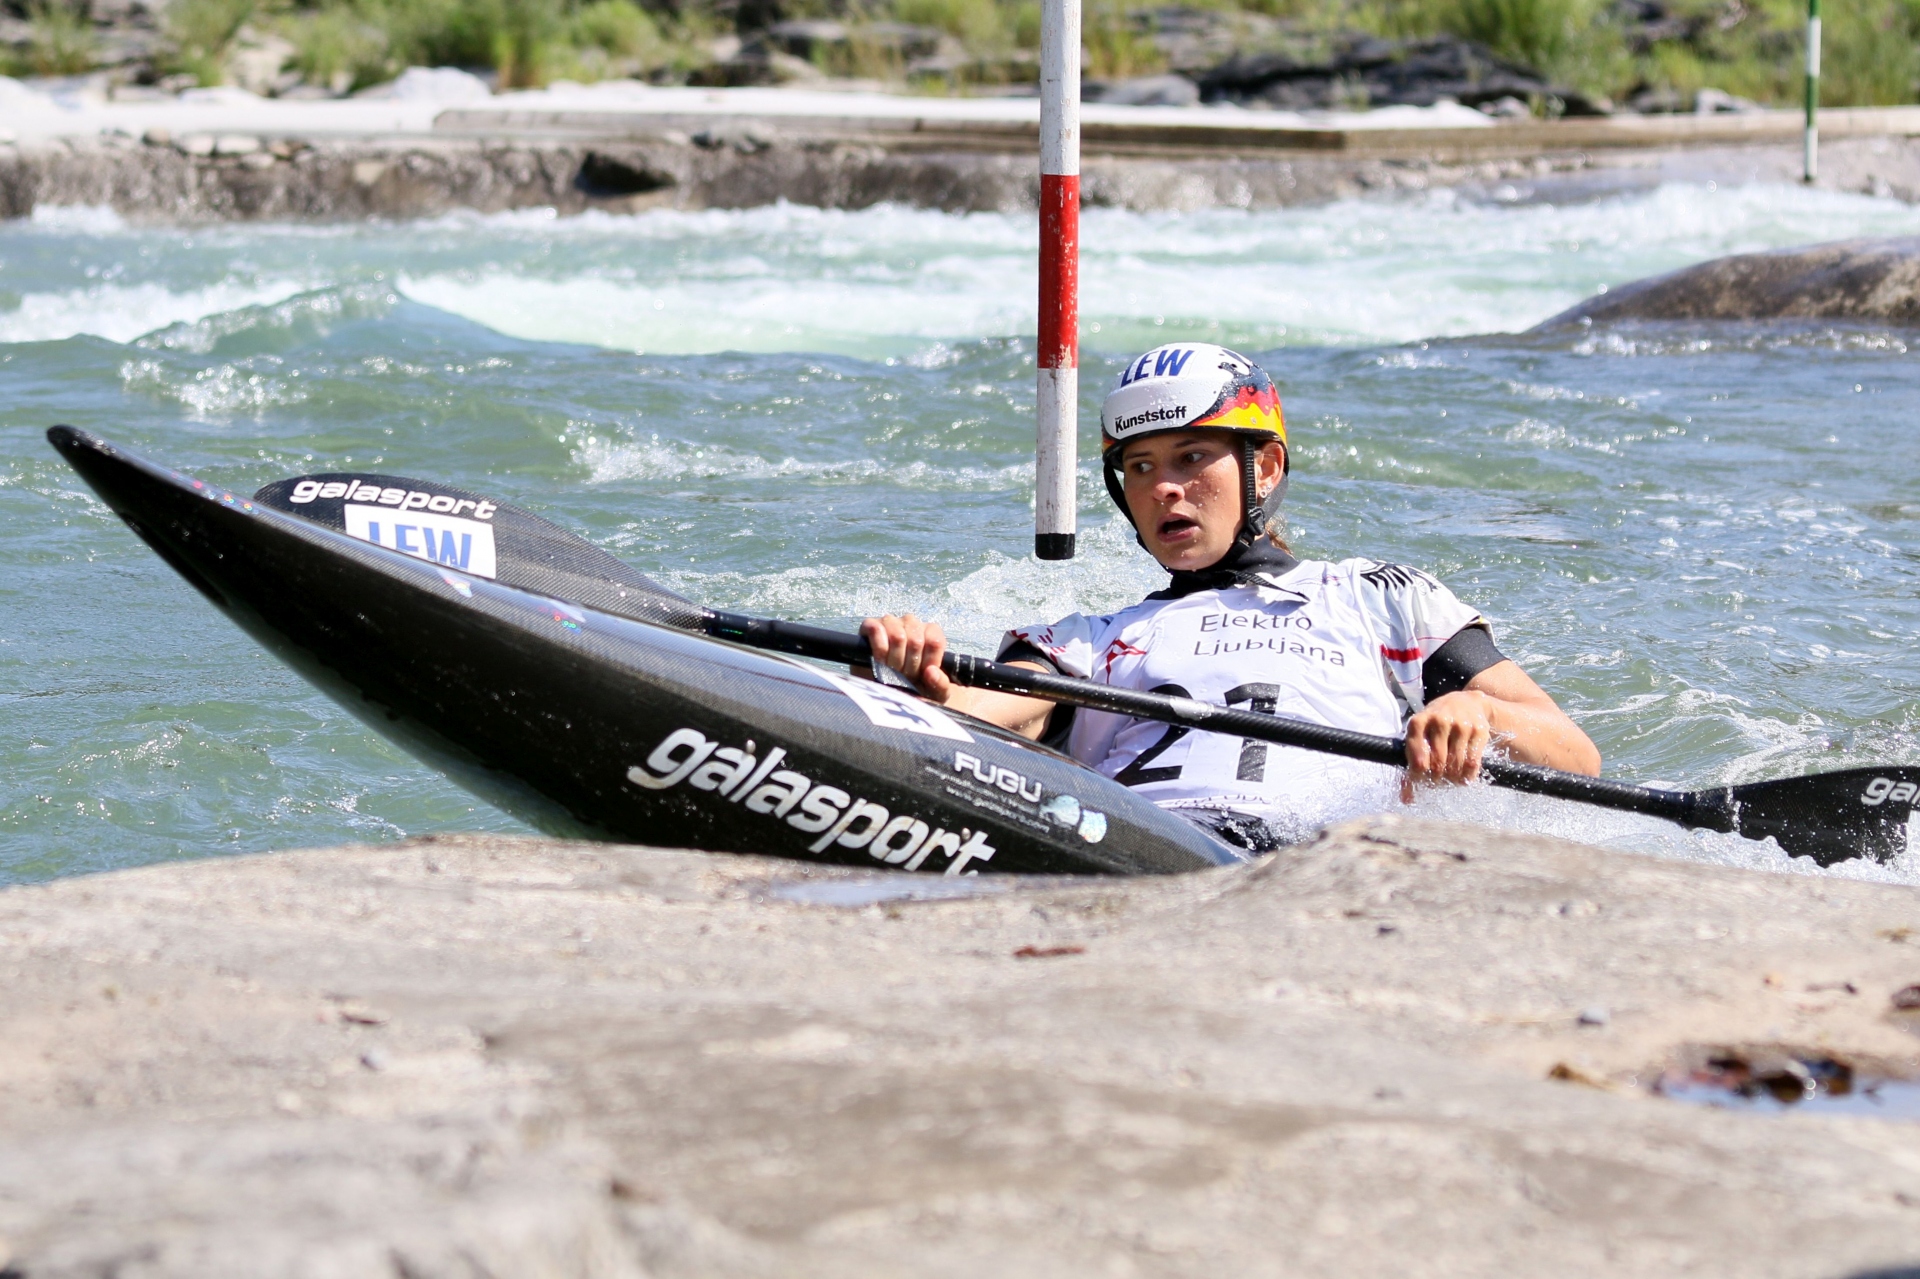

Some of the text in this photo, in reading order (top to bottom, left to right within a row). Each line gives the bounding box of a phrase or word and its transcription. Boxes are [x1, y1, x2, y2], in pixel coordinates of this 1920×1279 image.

[1120, 349, 1195, 388] LEW
[1115, 406, 1187, 433] Kunststoff
[289, 479, 498, 520] galasport
[1200, 613, 1312, 632] Elektro
[1194, 637, 1345, 667] Ljubljana
[1113, 682, 1281, 788] 21
[954, 750, 1043, 803] FUGU
[626, 727, 996, 877] galasport
